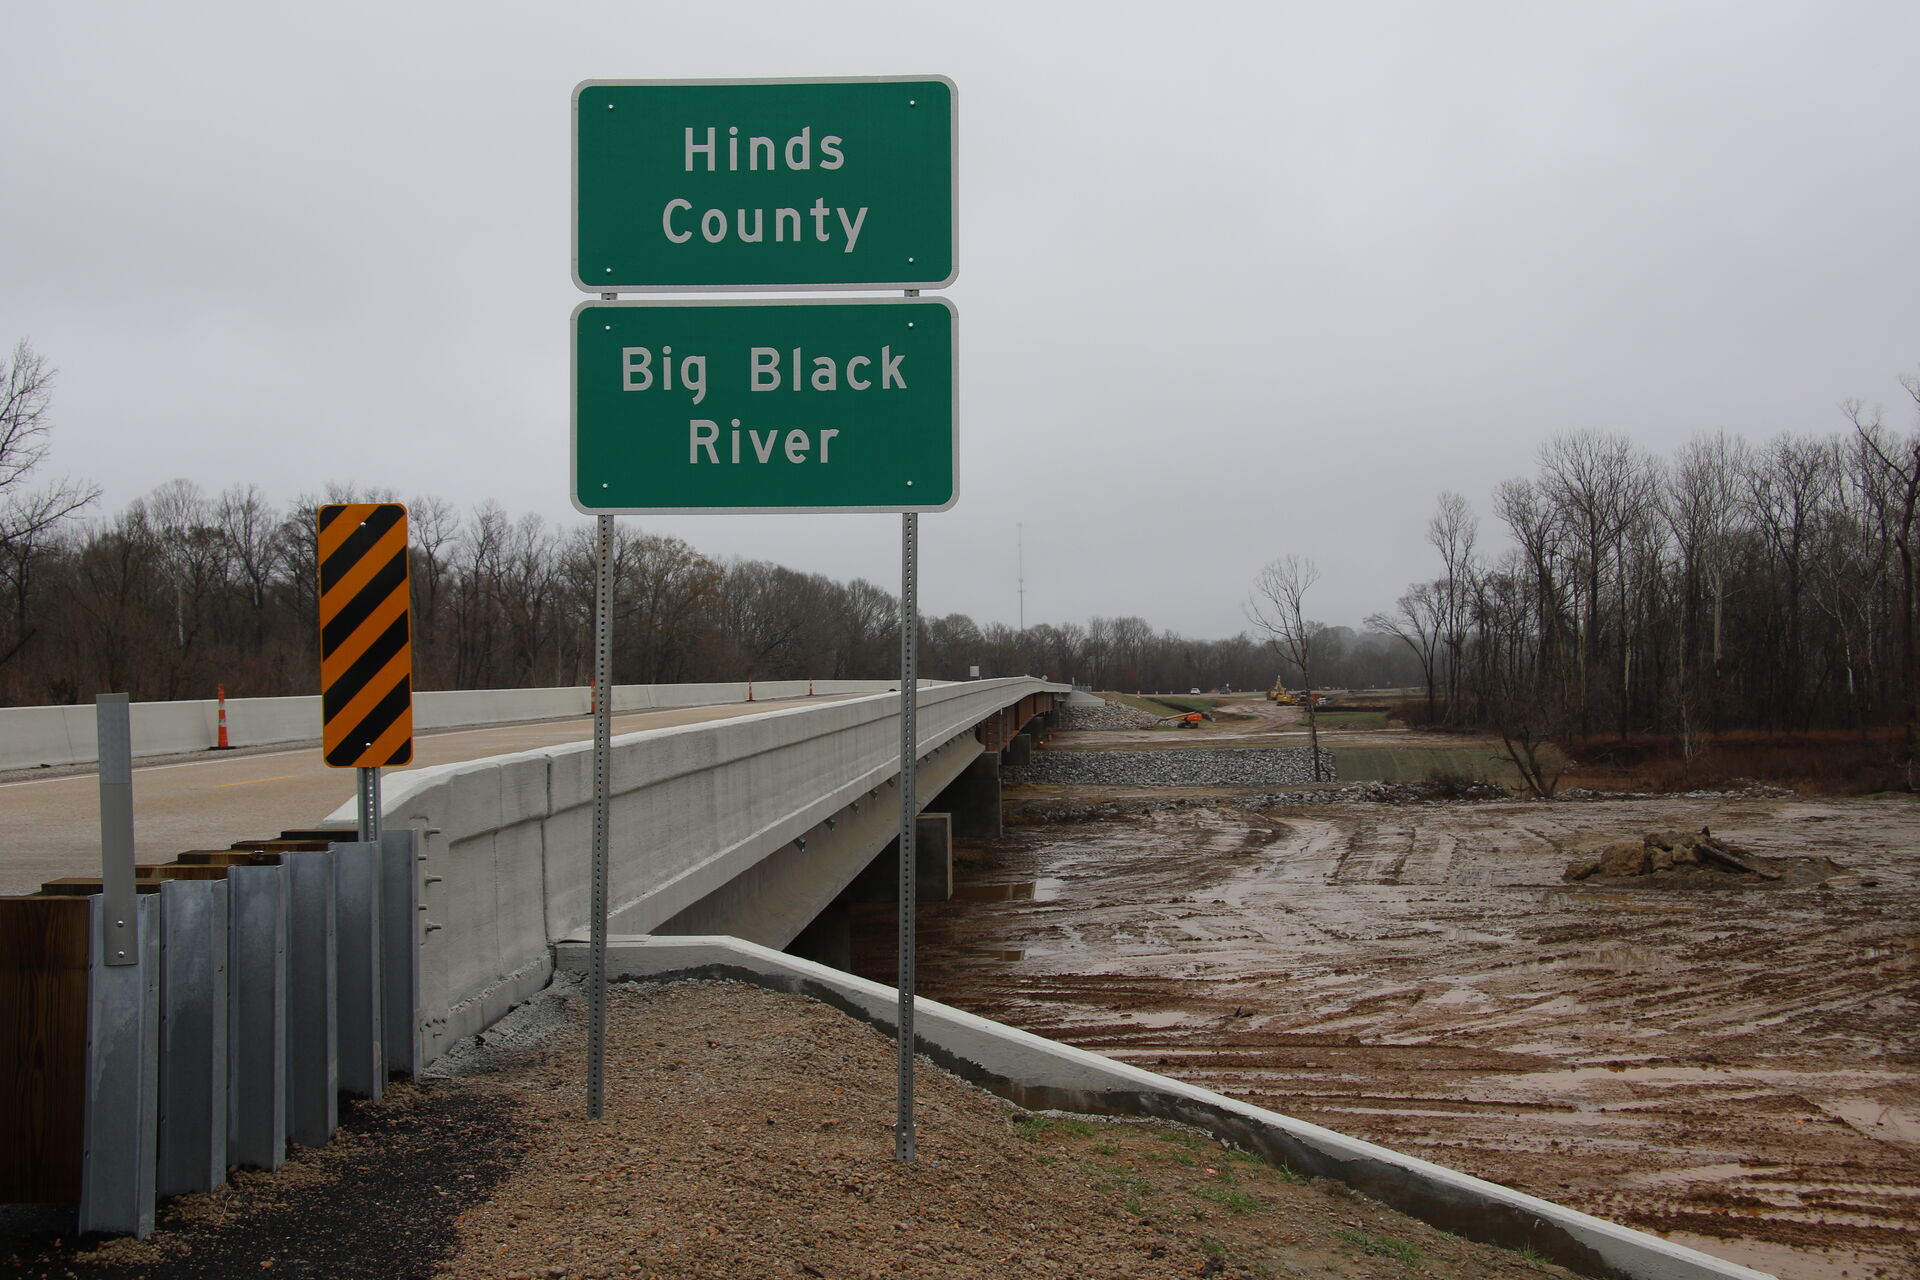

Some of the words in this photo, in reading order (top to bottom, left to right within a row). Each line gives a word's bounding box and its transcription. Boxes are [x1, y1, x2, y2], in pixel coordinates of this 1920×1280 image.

[684, 126, 846, 171] Hinds
[662, 197, 869, 253] County
[622, 345, 707, 405] Big
[750, 345, 908, 392] Black
[689, 418, 840, 464] River
